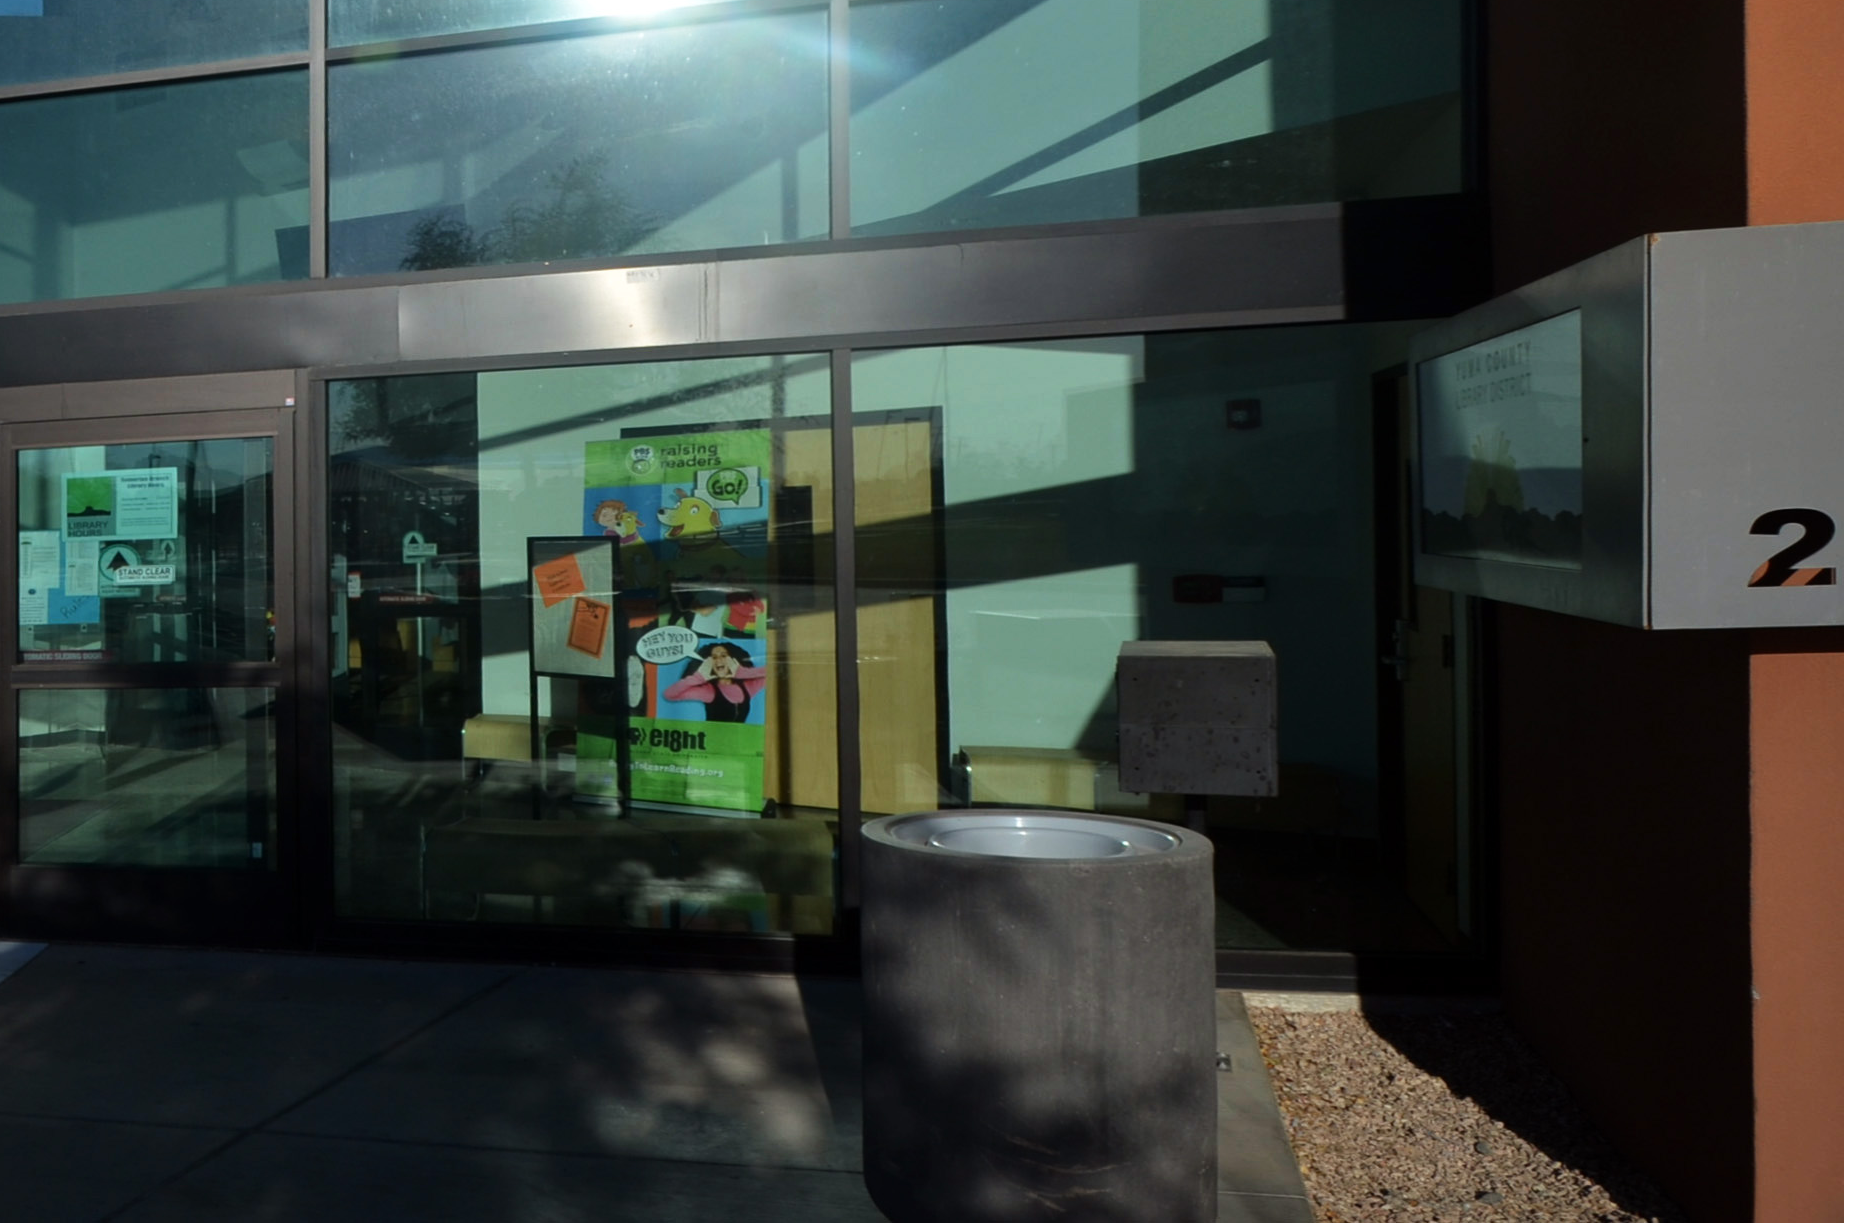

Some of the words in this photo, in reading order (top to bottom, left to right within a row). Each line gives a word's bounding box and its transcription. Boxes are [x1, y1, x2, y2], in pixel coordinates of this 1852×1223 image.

[660, 444, 718, 457] raising
[660, 457, 722, 469] readers
[68, 520, 109, 530] LIBRARY
[68, 529, 103, 538] HOURS
[1747, 508, 1837, 588] 2
[118, 568, 143, 576] STAND
[145, 567, 171, 575] CLEAR
[668, 633, 693, 643] YOU
